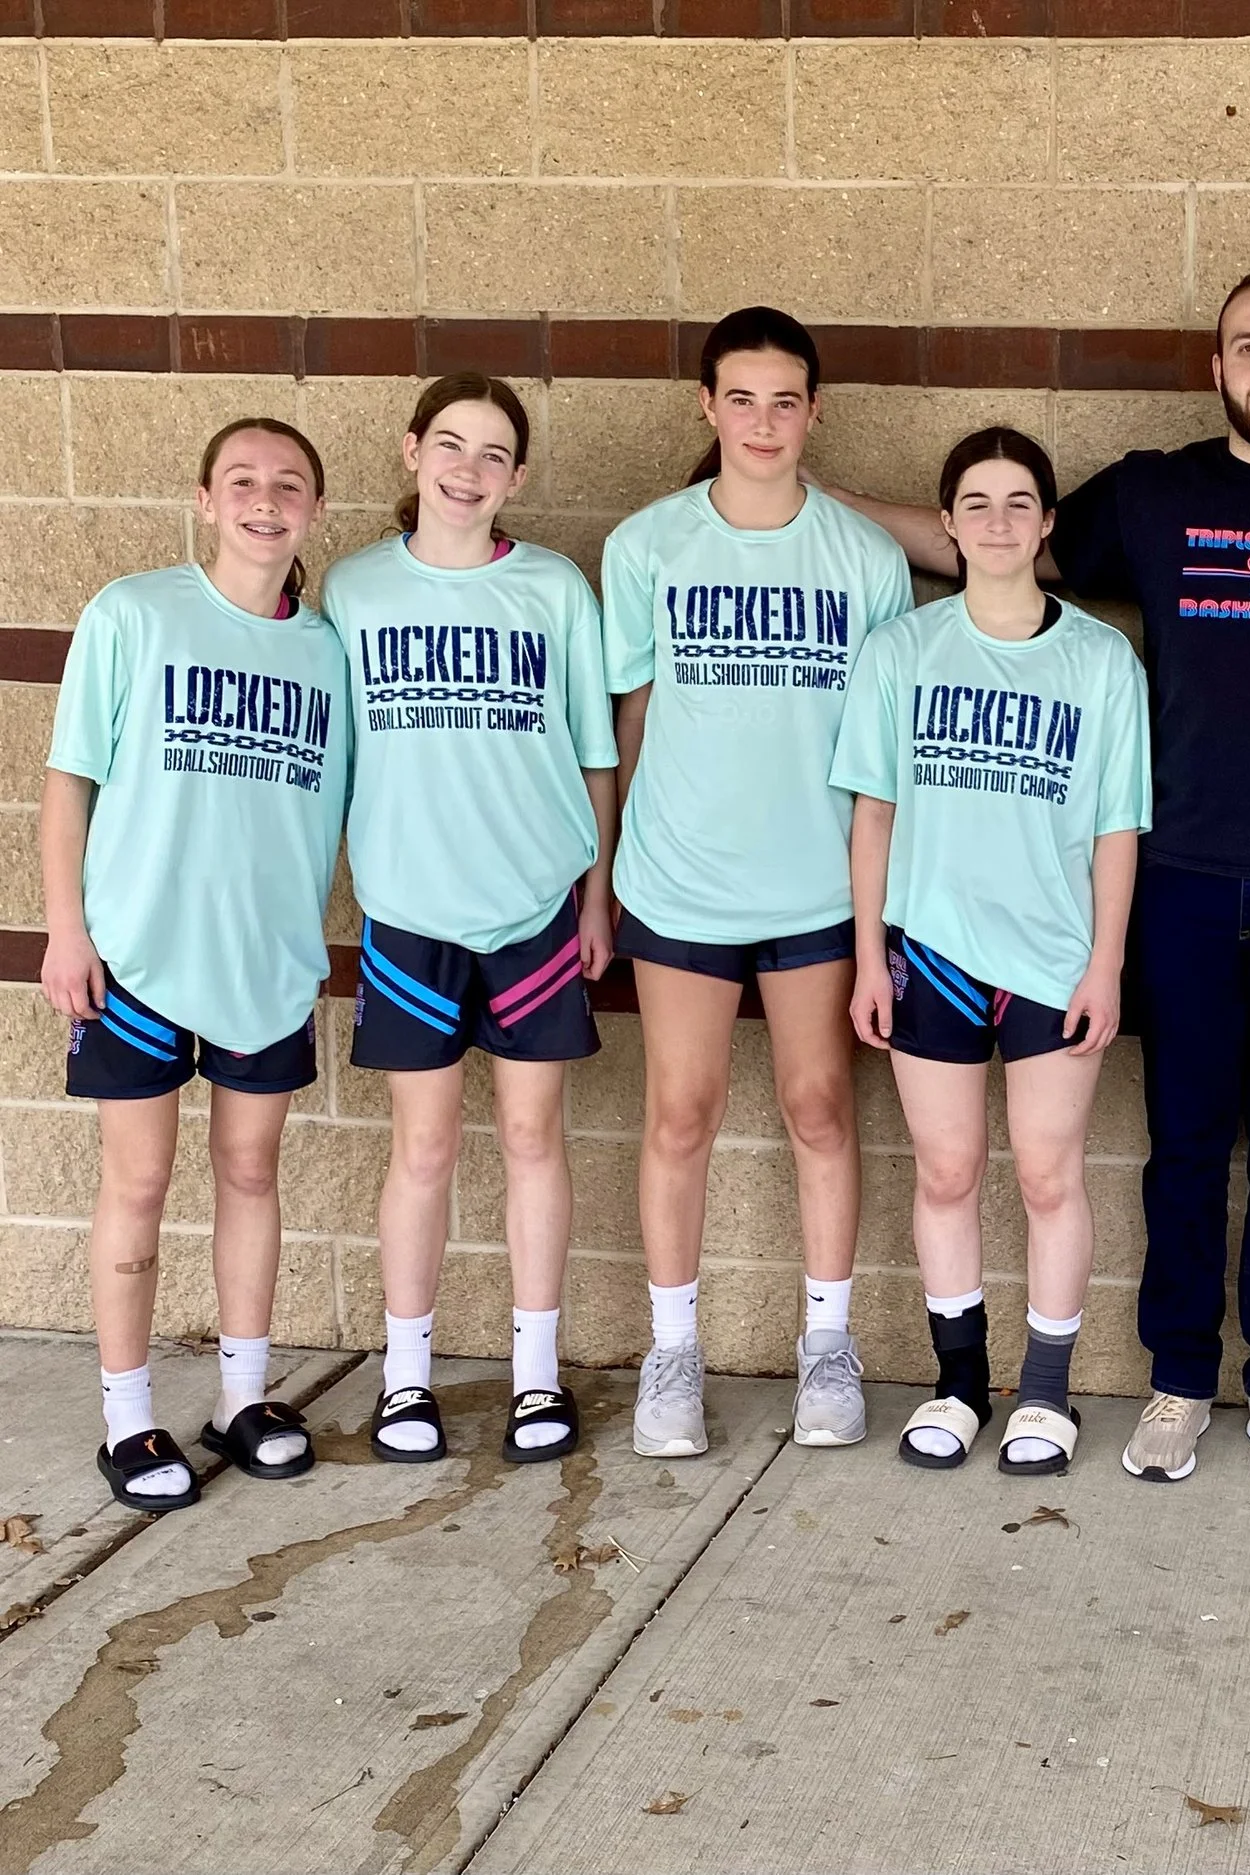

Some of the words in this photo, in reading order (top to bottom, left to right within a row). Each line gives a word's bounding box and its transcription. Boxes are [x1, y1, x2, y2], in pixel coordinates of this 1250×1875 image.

[667, 586, 806, 641] LOCKED
[815, 589, 848, 647] IN
[360, 626, 499, 685] LOCKED
[510, 630, 546, 689] IN
[675, 662, 789, 687] BBALLSHOOTOUT
[792, 665, 846, 691] CHAMPS
[164, 664, 302, 739] LOCKED
[304, 687, 331, 749] IN
[487, 708, 546, 734] CHAMPS
[913, 685, 1041, 751] LOCKED
[1046, 700, 1081, 761] IN
[164, 748, 284, 782] BBALLSHOOTOUT
[913, 763, 1017, 793] BALLSHOOTOUT
[389, 1390, 423, 1407] NIKE
[521, 1393, 555, 1408] NIKE
[1018, 1411, 1047, 1424] nike
